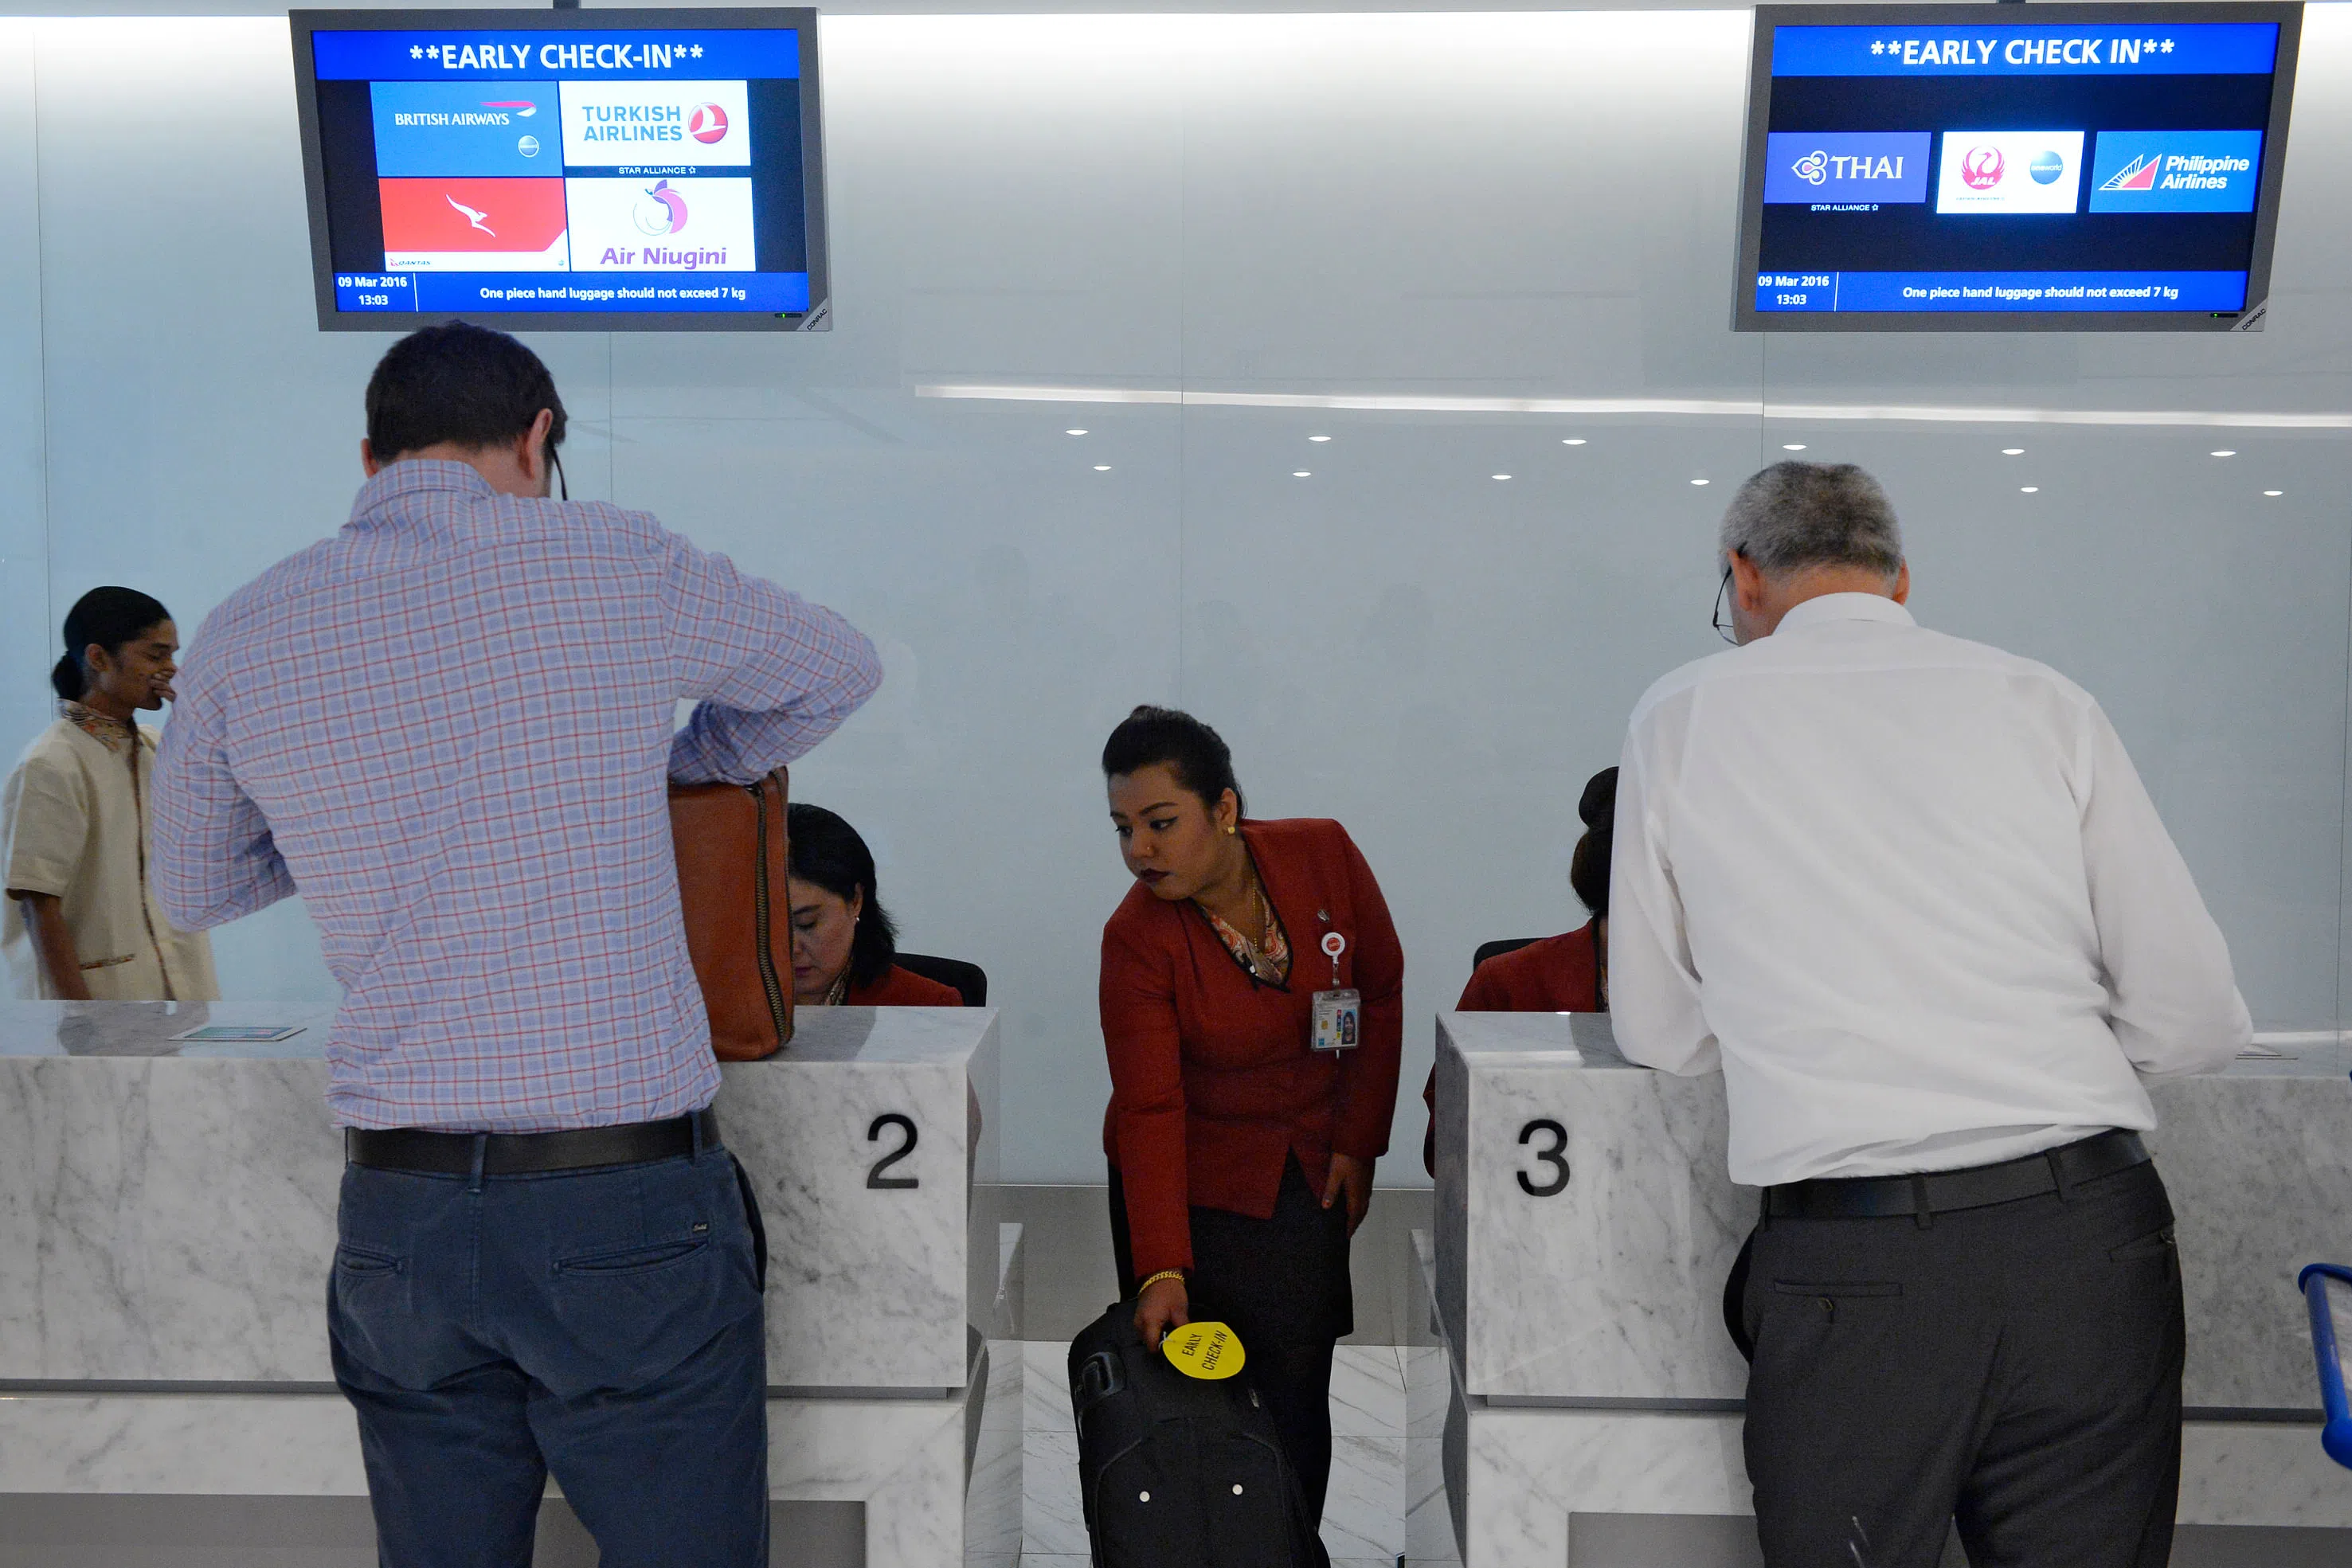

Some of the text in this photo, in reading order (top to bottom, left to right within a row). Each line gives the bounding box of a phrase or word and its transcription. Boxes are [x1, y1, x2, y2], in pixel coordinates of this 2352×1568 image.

[2004, 39, 2104, 65] CHECK
[394, 113, 510, 126] BRITISH AIRWAYS
[581, 105, 681, 122] TURKISH
[583, 125, 683, 142] AIRLINES
[1829, 155, 1904, 179] THAI
[2165, 155, 2250, 174] Philippine
[1970, 176, 1996, 186] JAL
[2159, 173, 2228, 190] Airlines
[600, 247, 727, 270] Air Niugini
[338, 276, 408, 287] 09 Mar 2016
[1758, 276, 1830, 287] 09 Mar 2016
[358, 295, 389, 306] 13:03
[479, 287, 746, 301] One piece hand luggage should not exceed 7 kg
[1776, 294, 1807, 305] 13:03
[1902, 286, 2179, 300] One piece hand luggage should not exceed 7 kg
[806, 308, 828, 330] CONRAC
[2241, 308, 2267, 330] CONRAC
[866, 1113, 919, 1189] 2
[1516, 1119, 1571, 1198] 3
[1182, 1333, 1203, 1357] EARLY
[1201, 1330, 1228, 1371] CHECK-IN
